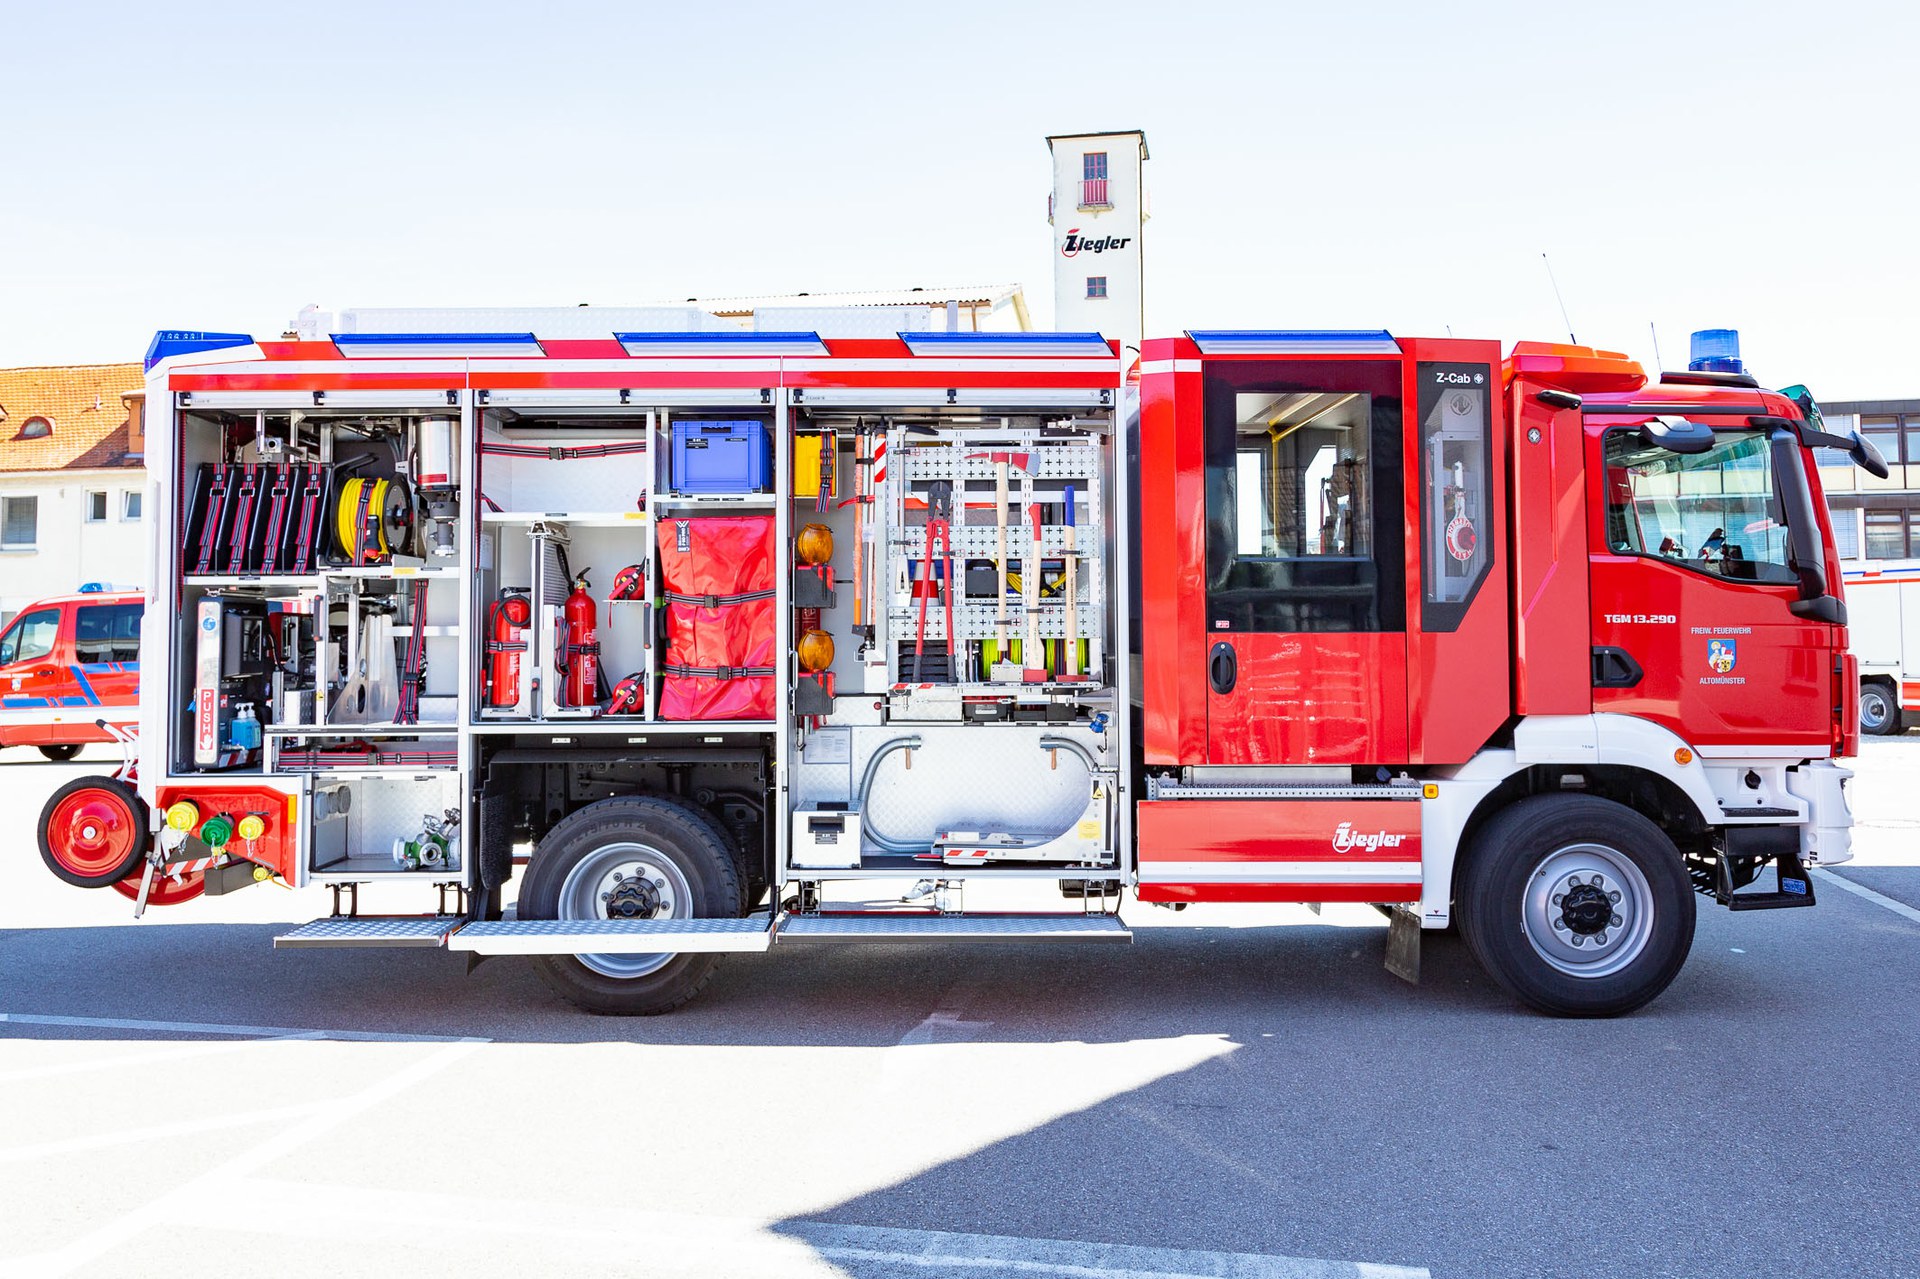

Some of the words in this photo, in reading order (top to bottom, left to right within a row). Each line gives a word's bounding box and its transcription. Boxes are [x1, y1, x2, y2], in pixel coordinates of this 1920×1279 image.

[1063, 231, 1131, 255] Ziegler
[1436, 372, 1471, 384] Z-Cab
[1604, 614, 1632, 624] TGM
[1632, 614, 1677, 624] 13.290
[1713, 627, 1752, 635] FEUERWEHR
[1699, 675, 1746, 685] ALTOMÜNSTER
[202, 691, 212, 733] PUSH
[1333, 824, 1406, 853] Ziegler
